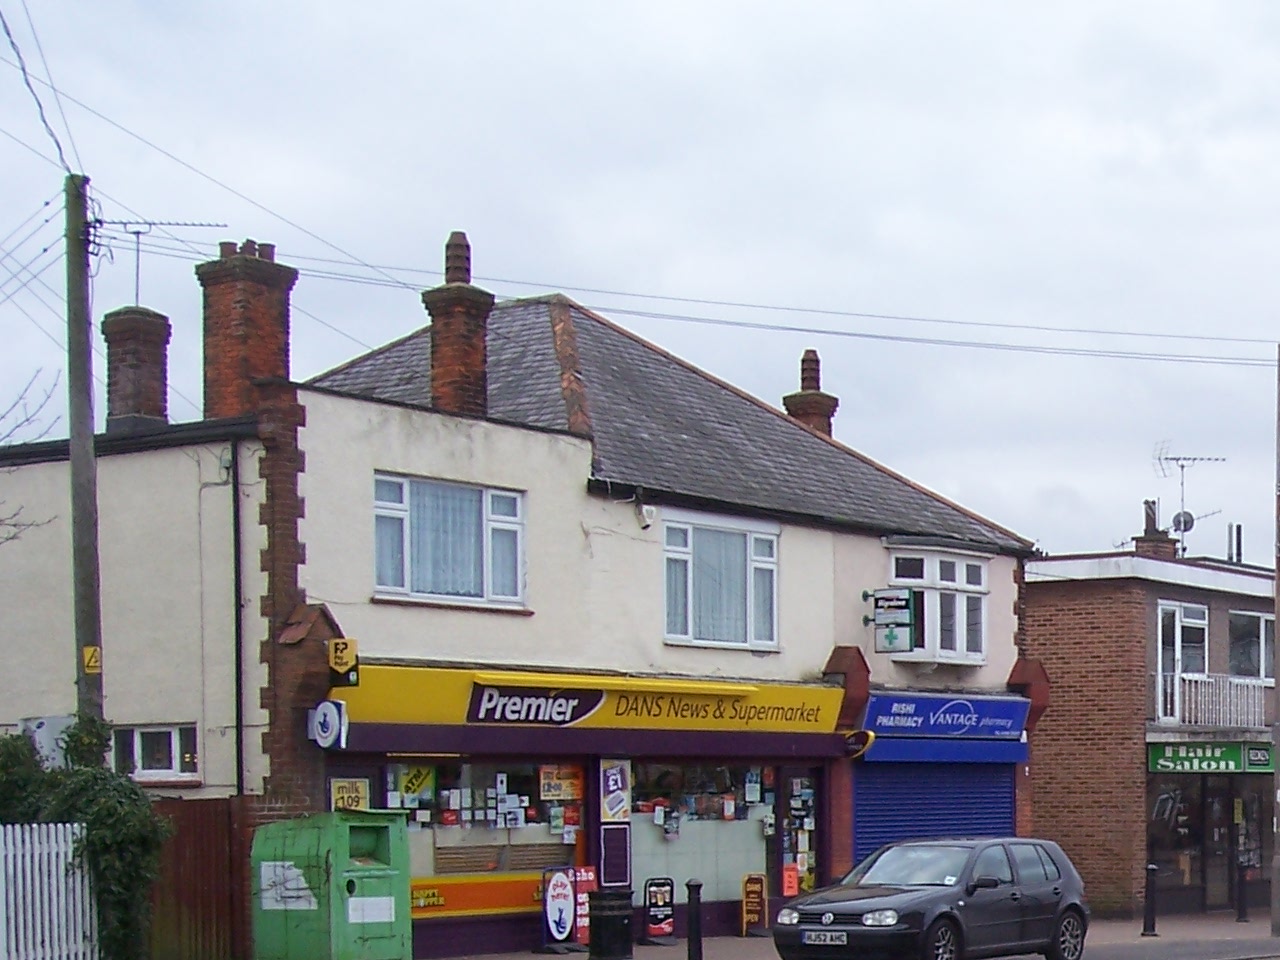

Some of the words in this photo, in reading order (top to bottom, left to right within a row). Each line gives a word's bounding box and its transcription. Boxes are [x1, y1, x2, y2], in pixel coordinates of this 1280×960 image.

[477, 687, 580, 723] Premier
[614, 694, 662, 719] DANS
[666, 697, 710, 720] News
[712, 698, 726, 720] &
[728, 699, 822, 726] Supermarket
[890, 702, 916, 715] RISHI
[875, 714, 925, 728] PHARMACY
[928, 711, 980, 727] VANTAGE
[978, 716, 1014, 729] pharmacy
[1163, 744, 1228, 758] Hair
[1156, 757, 1236, 771] Salon
[336, 781, 361, 795] milk
[607, 775, 622, 791] £1
